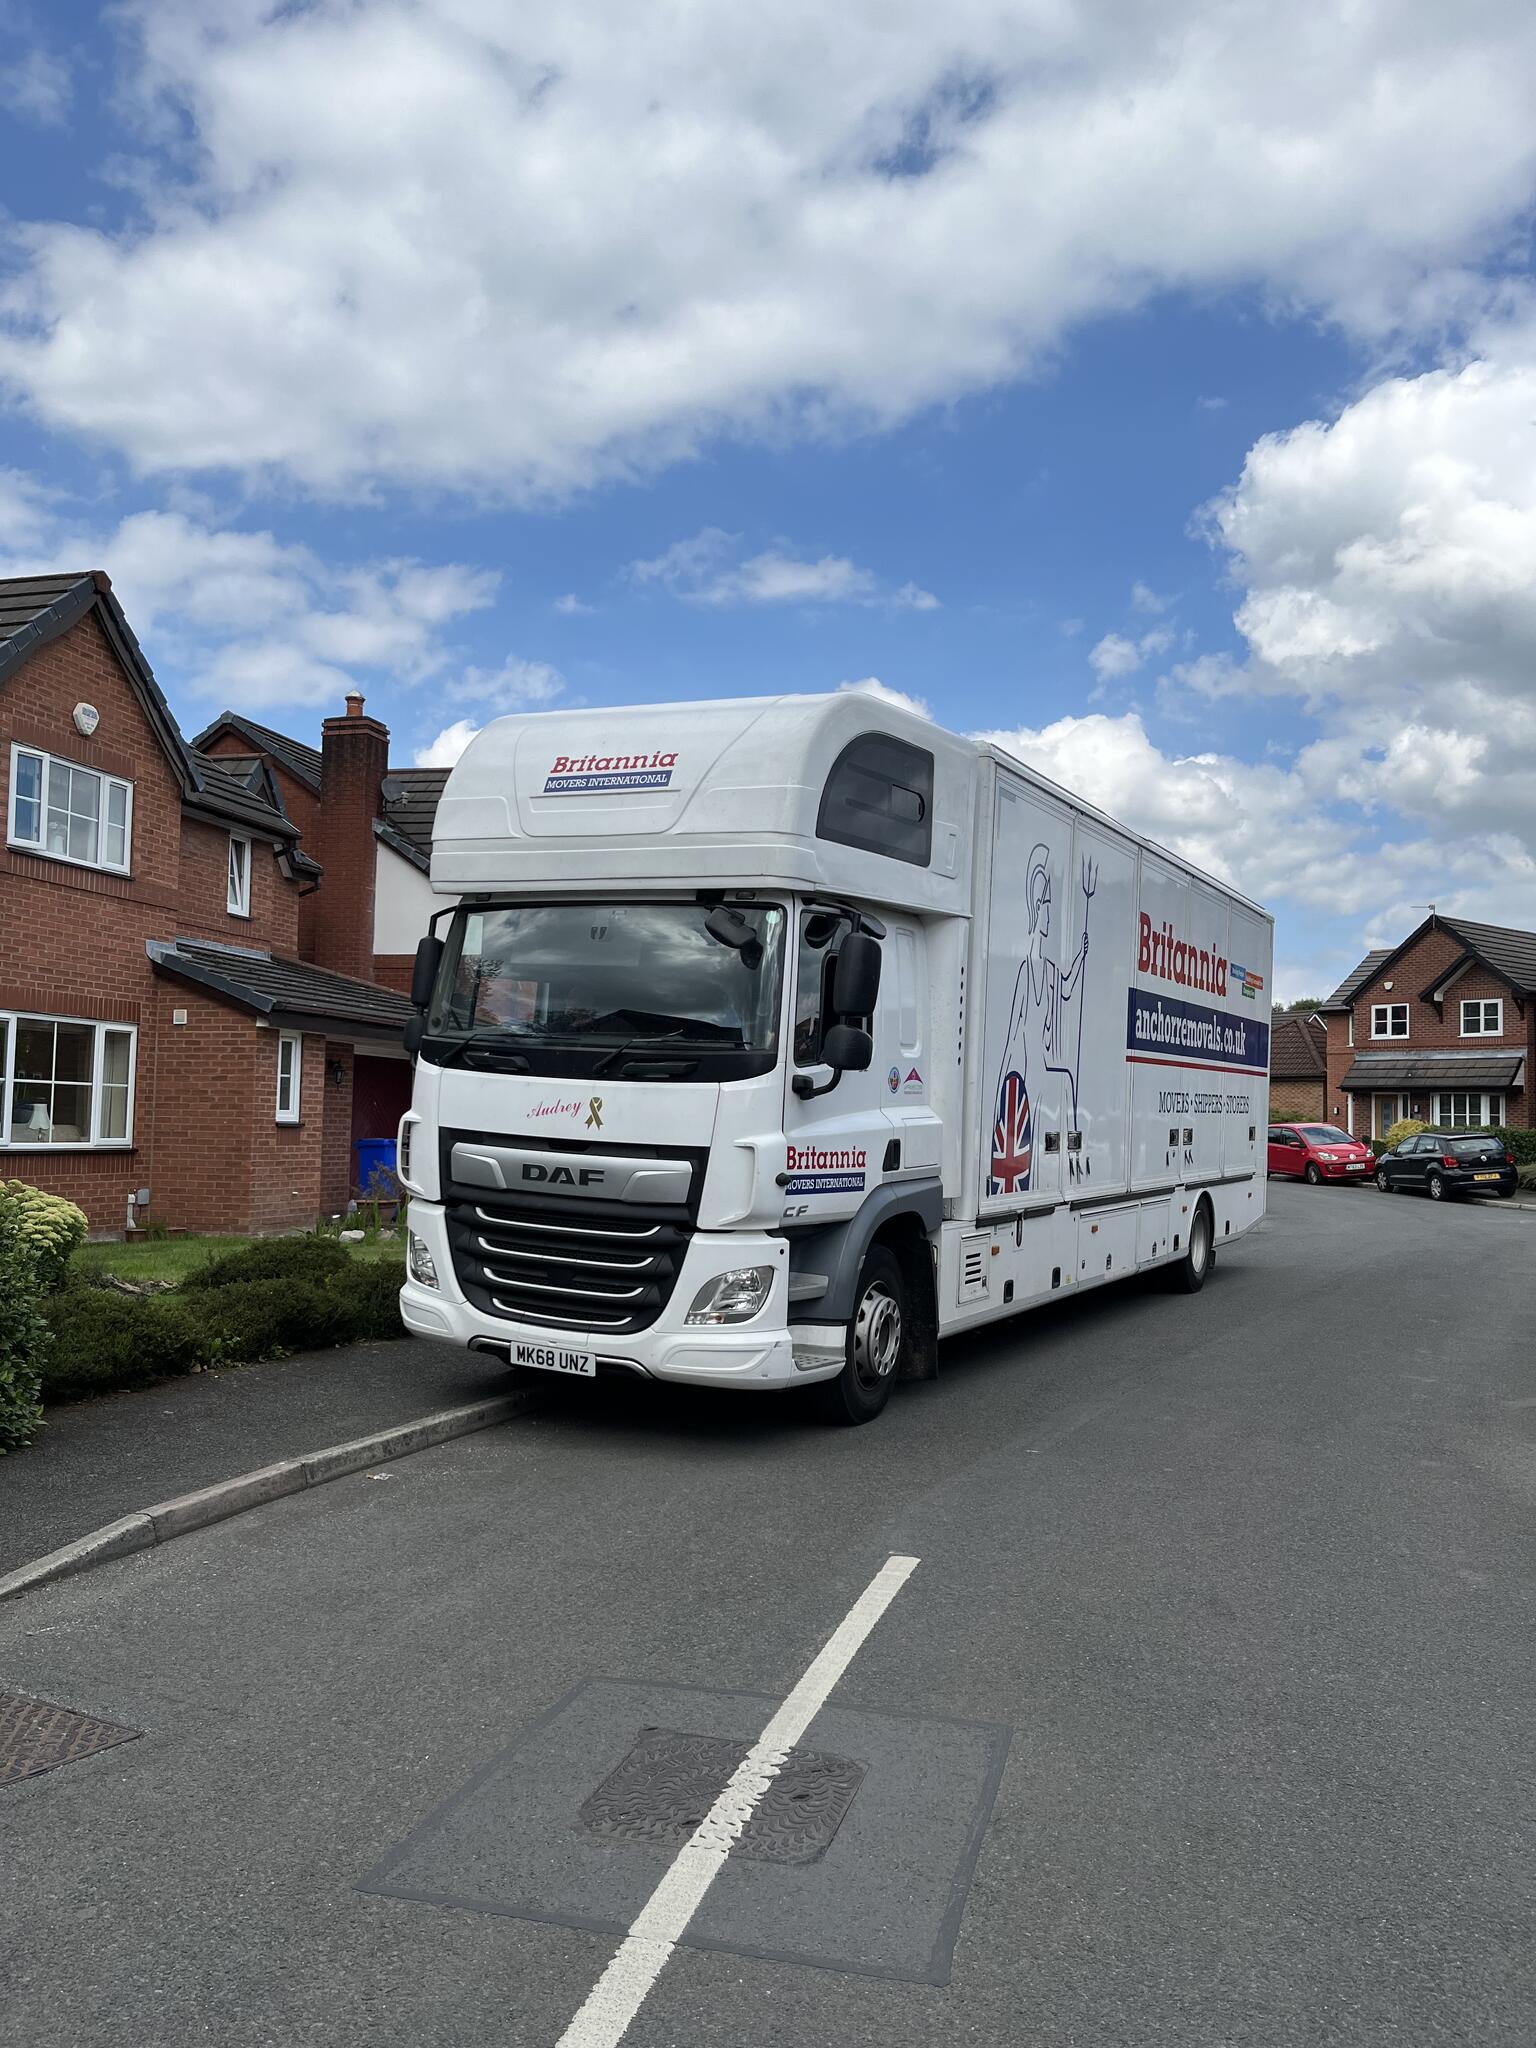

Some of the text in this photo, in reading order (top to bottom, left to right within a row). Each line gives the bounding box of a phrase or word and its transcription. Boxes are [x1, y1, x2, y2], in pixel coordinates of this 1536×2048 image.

[550, 751, 679, 774] Britannia
[546, 774, 667, 790] MOVERS INTERNATIONAL
[1138, 911, 1228, 997] Britannia
[1135, 1001, 1246, 1056] anchorremovals.co.uk
[526, 1099, 584, 1119] Audrey
[1158, 1091, 1190, 1114] MOVERS
[786, 1145, 866, 1170] Britannia
[522, 1163, 605, 1186] DAF
[815, 1176, 864, 1189] INTERNATIONAL
[783, 1204, 809, 1218] CF
[516, 1345, 589, 1373] MK68 UNZ
